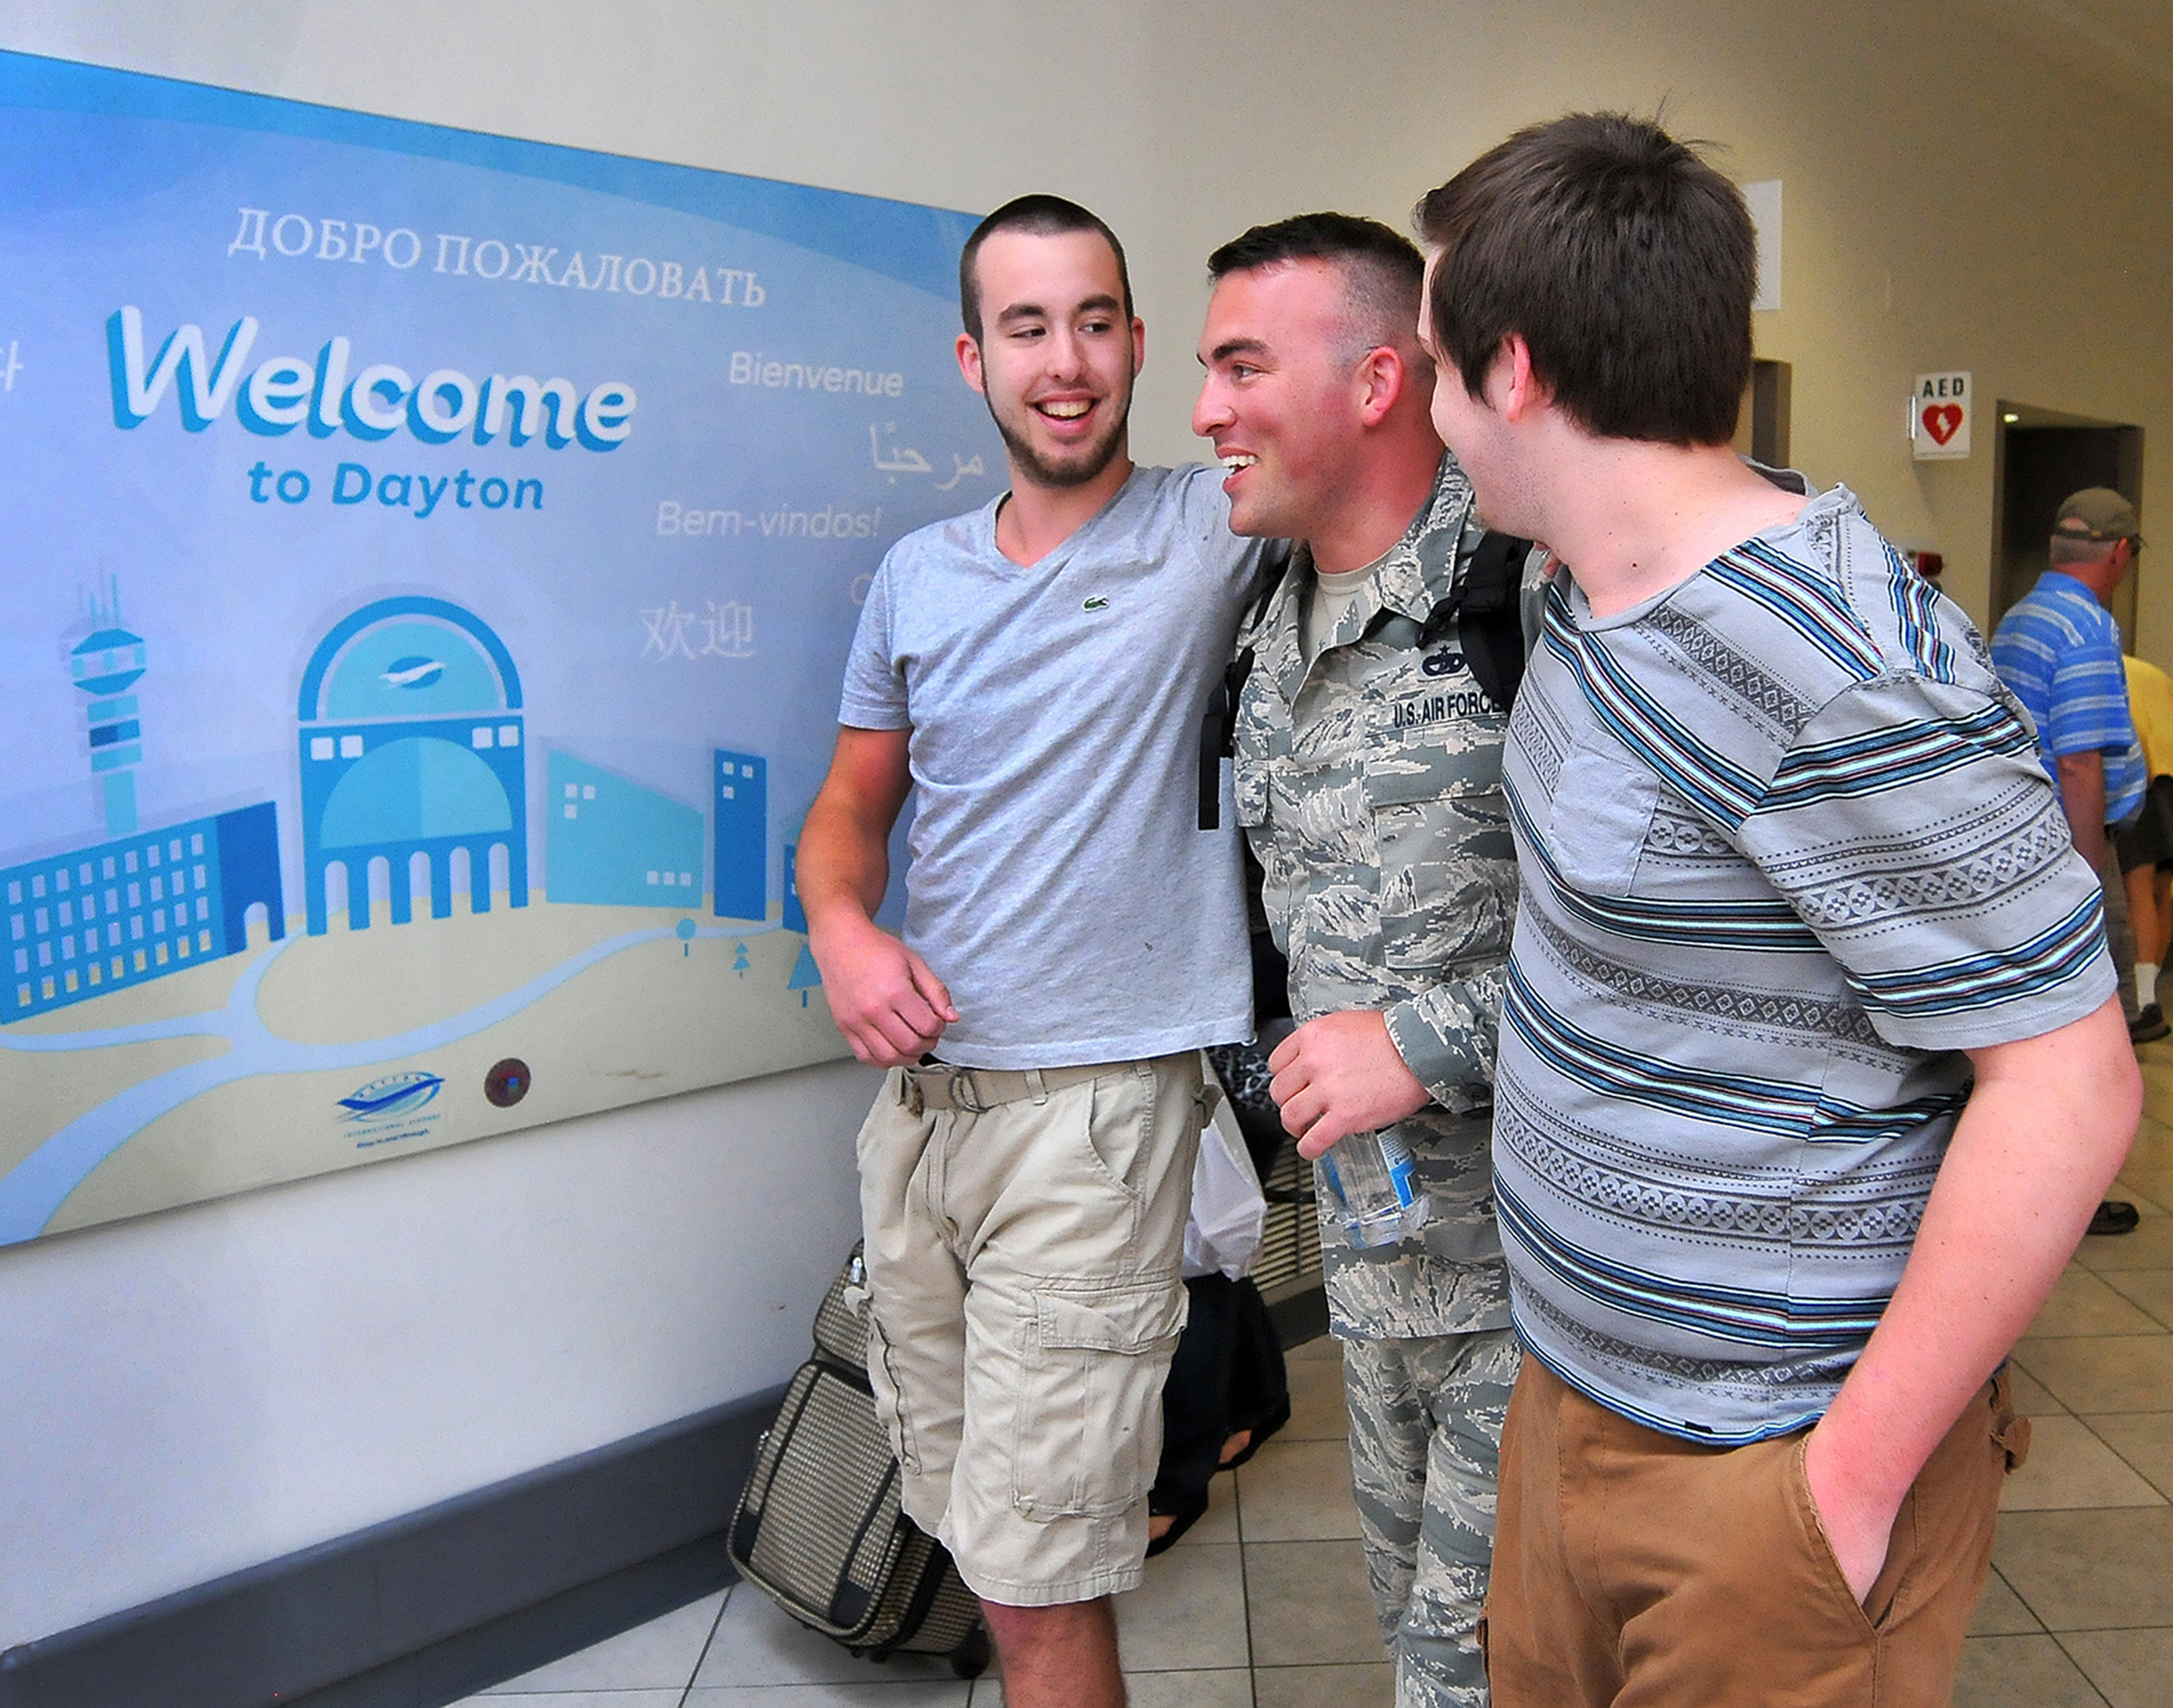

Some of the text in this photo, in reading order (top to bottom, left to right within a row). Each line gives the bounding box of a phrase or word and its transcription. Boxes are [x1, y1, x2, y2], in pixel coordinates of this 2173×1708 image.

[227, 207, 422, 270] ДОБРО
[105, 305, 638, 453] Welcome
[729, 351, 904, 397] Bienvenue
[1923, 377, 1964, 398] AED
[248, 460, 546, 519] to Dayton
[656, 501, 882, 538] Bem-vindos!
[640, 600, 757, 661] 欢迎
[1422, 697, 1444, 722] AIR
